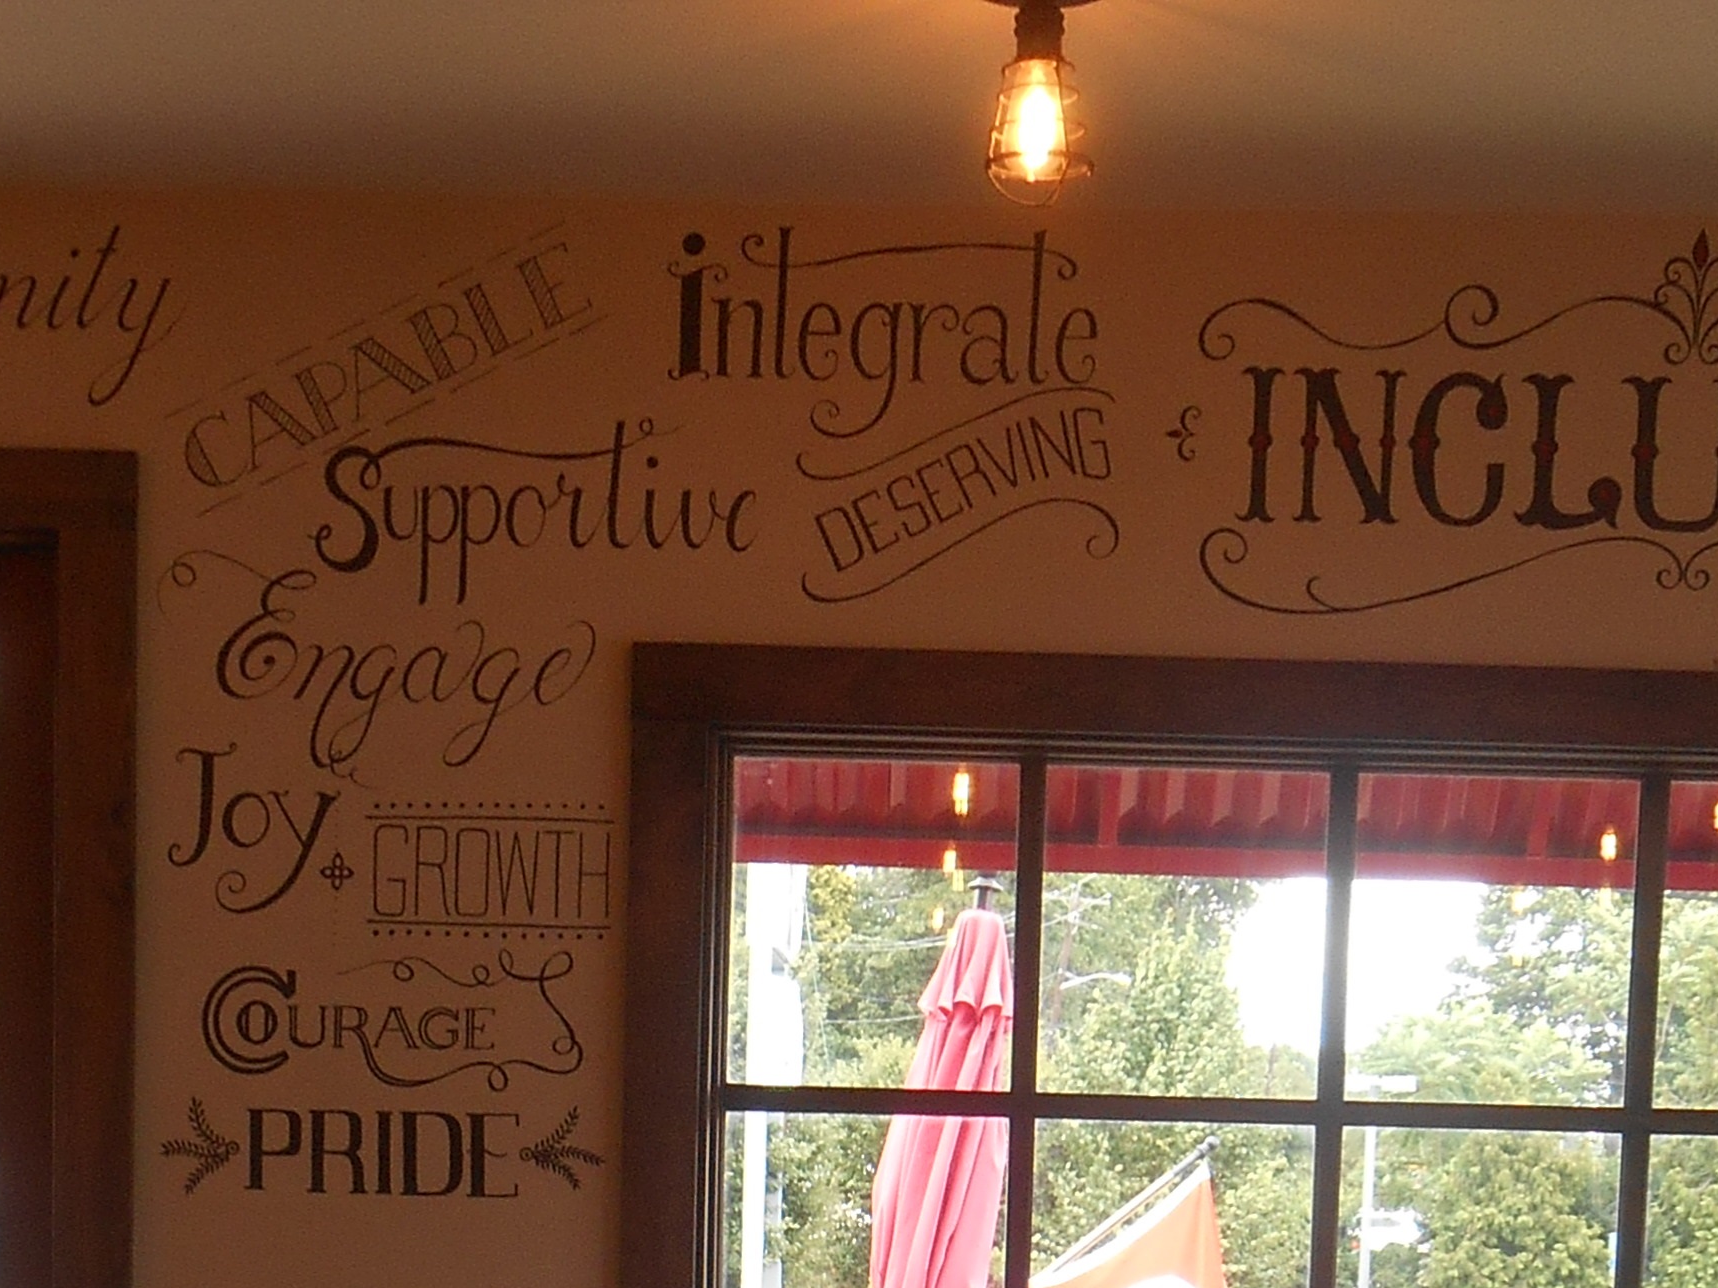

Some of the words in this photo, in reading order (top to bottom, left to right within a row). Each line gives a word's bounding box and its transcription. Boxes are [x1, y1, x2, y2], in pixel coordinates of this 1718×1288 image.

[183, 241, 593, 490] CAPABLE
[308, 418, 759, 606] Supportive
[815, 406, 1112, 574] DESERVING
[215, 569, 596, 769] Engage
[167, 741, 341, 914] Joy
[371, 822, 612, 920] GROWTH
[243, 1107, 520, 1199] PRIDE
